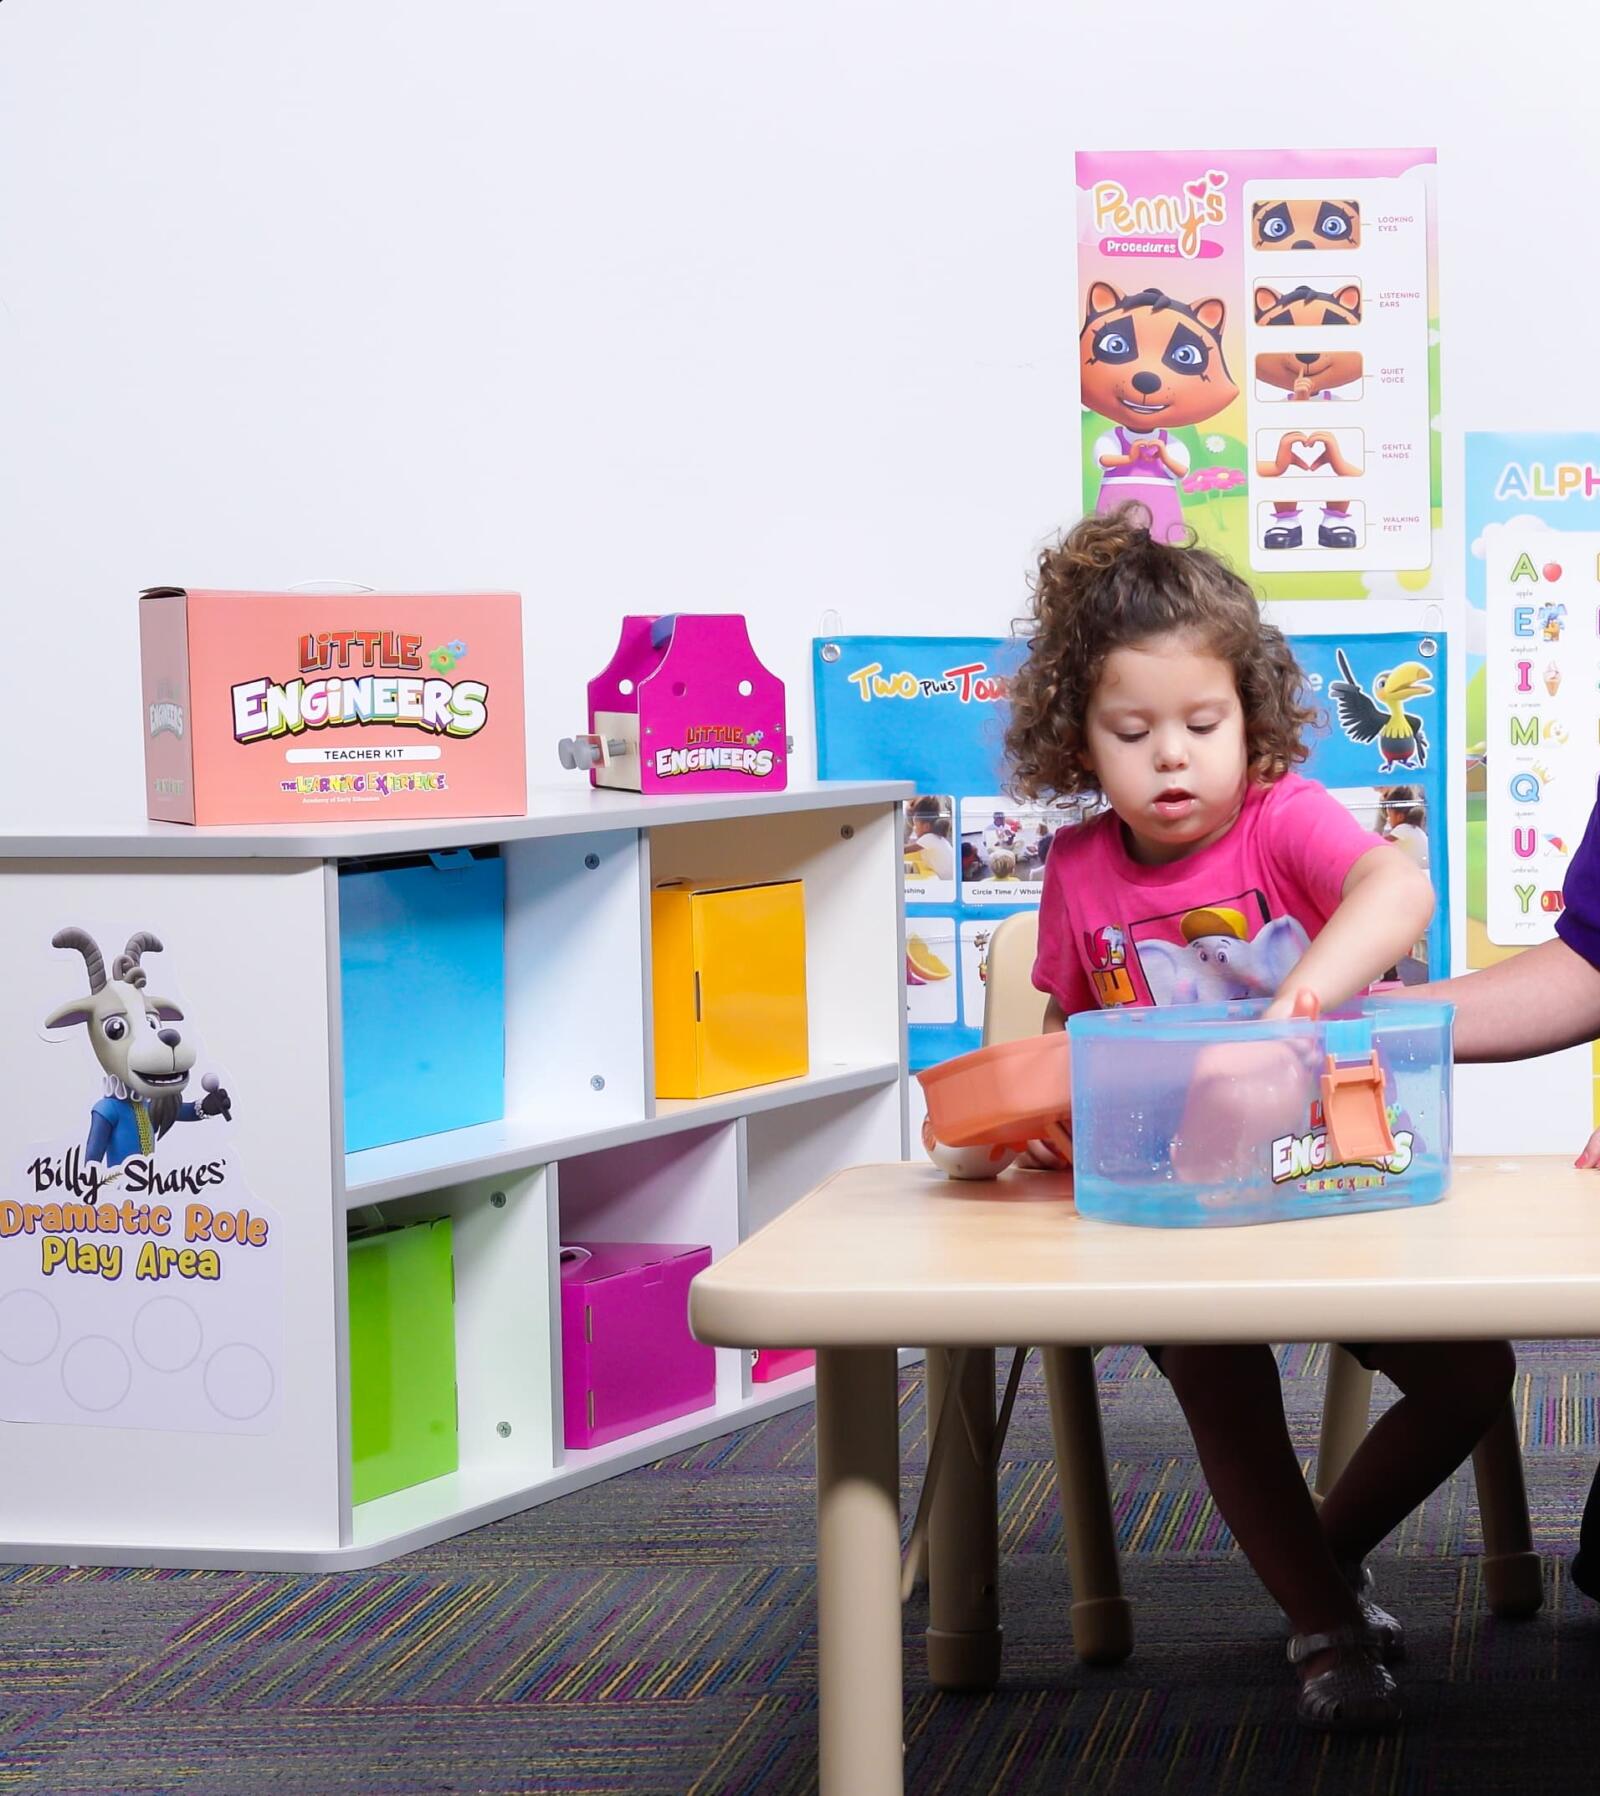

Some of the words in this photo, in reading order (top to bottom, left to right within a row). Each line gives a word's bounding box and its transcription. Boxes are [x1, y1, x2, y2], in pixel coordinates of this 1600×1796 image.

[1378, 216, 1414, 224] LOOKING
[1106, 240, 1177, 254] Procedures
[1510, 553, 1538, 583] A
[1514, 607, 1534, 636] E
[850, 664, 918, 700] Two
[1518, 662, 1532, 691] I
[1511, 716, 1539, 746] M
[324, 750, 381, 760] TEACHER
[385, 749, 404, 759] KIT
[1510, 773, 1540, 803] Q
[1514, 828, 1536, 858] U
[1514, 884, 1536, 913] Y
[27, 1144, 102, 1205] Billy
[0, 1200, 172, 1237] Dramatic
[185, 1203, 268, 1247] Role
[42, 1235, 123, 1282] Play
[136, 1241, 221, 1281] Area
